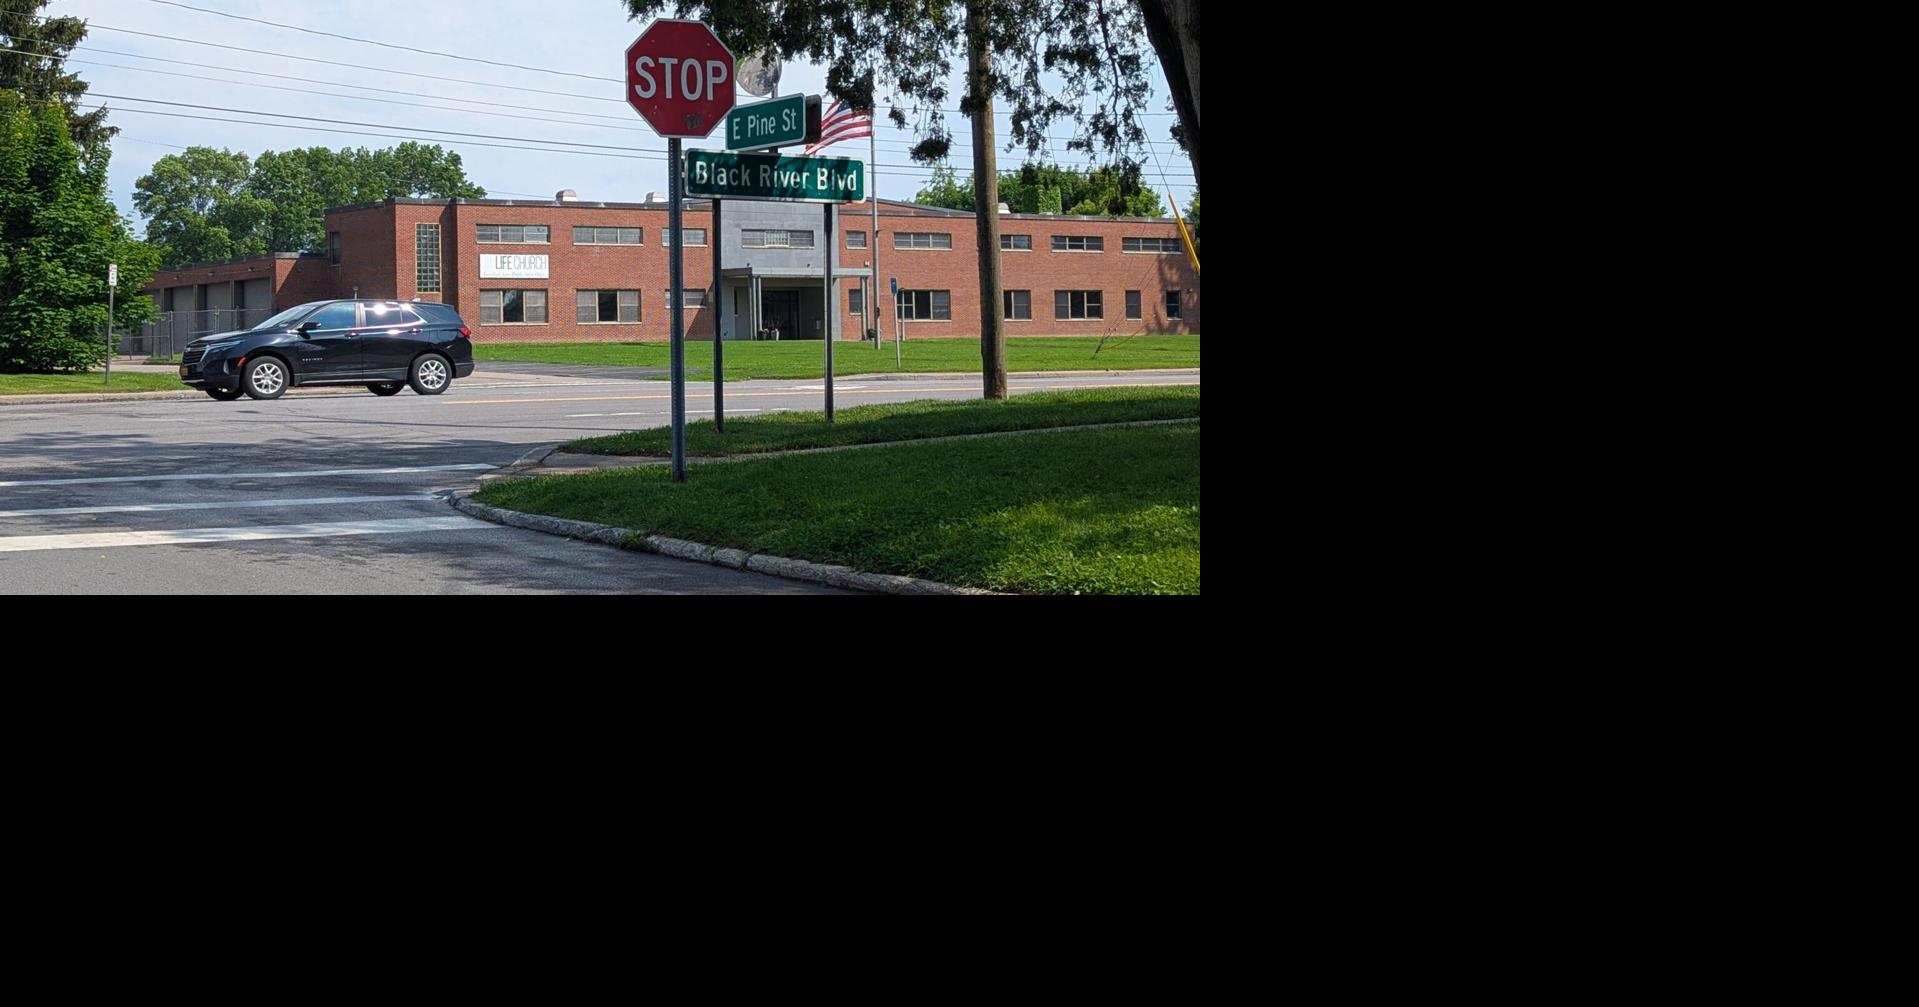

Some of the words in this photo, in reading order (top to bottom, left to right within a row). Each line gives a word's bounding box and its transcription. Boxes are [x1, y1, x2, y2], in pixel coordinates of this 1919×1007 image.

[634, 55, 728, 101] STOP
[732, 117, 741, 141] E
[747, 113, 776, 137] Pine
[782, 108, 797, 132] St
[695, 160, 751, 187] Black
[758, 164, 810, 190] River
[816, 167, 857, 192] Blvd
[495, 255, 513, 270] LIFE
[513, 255, 547, 270] CHURCH
